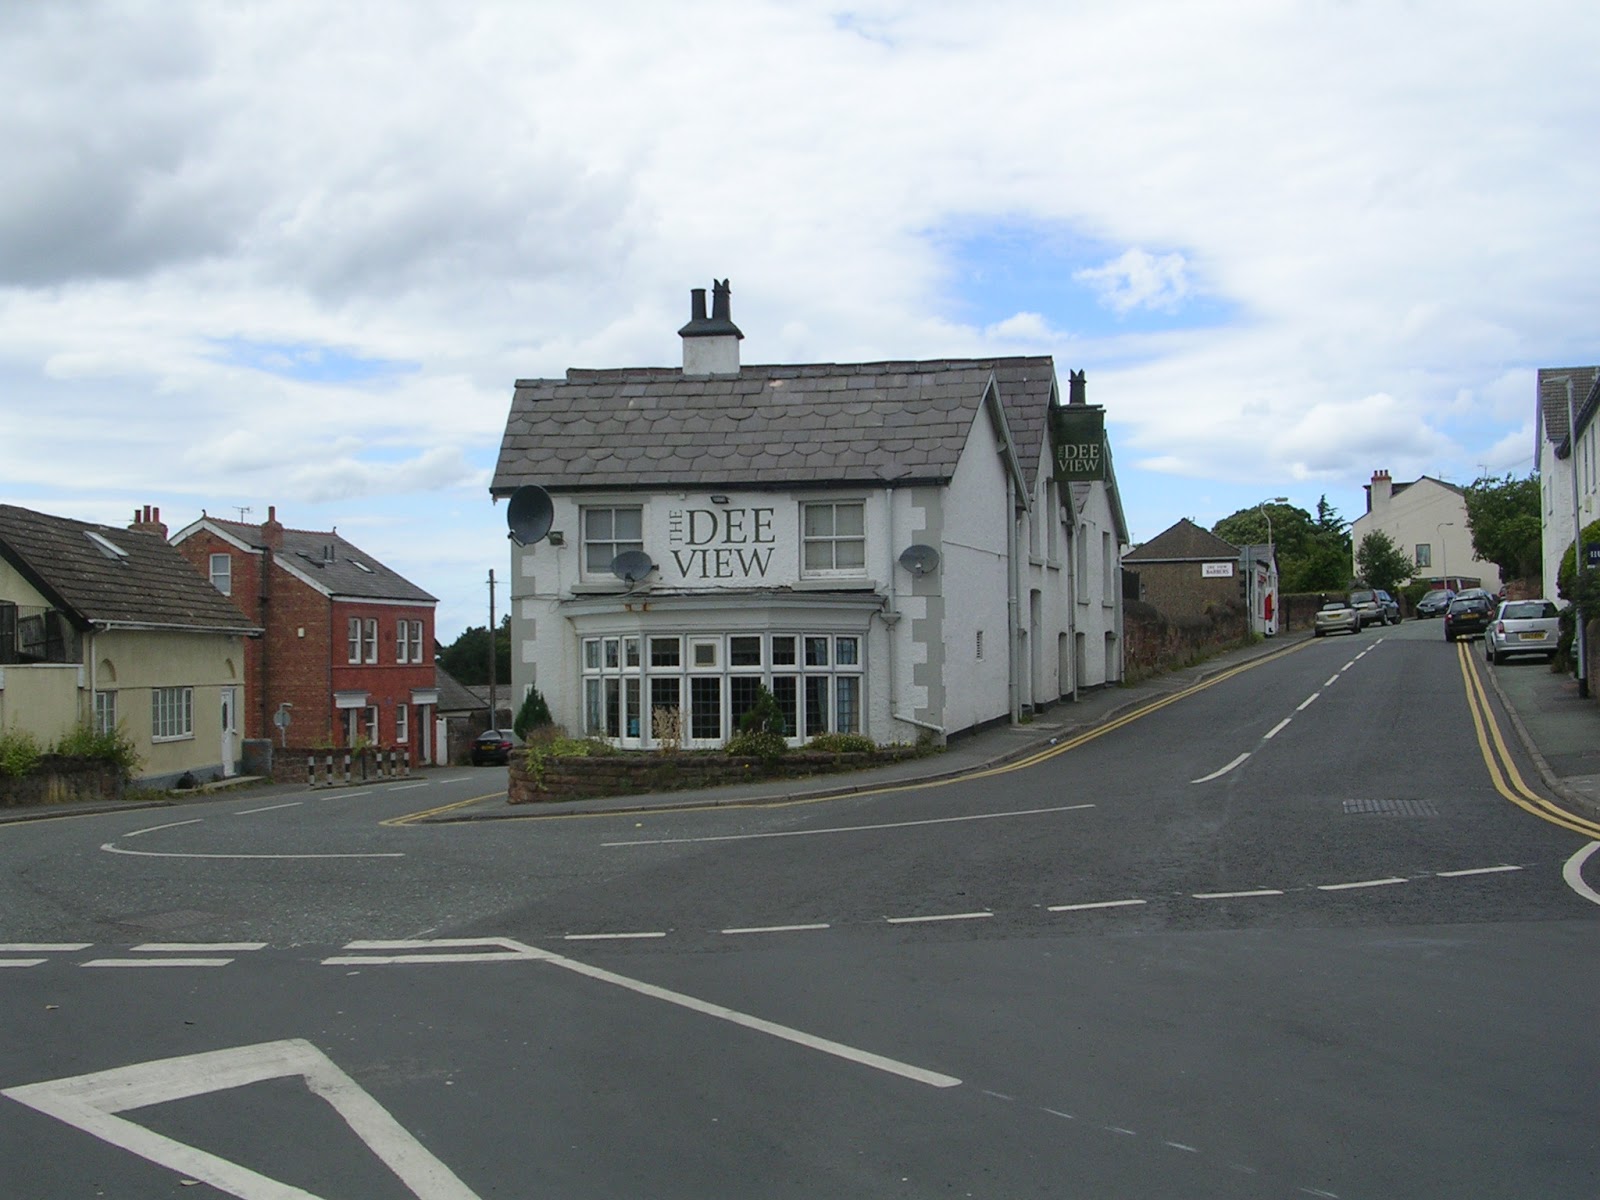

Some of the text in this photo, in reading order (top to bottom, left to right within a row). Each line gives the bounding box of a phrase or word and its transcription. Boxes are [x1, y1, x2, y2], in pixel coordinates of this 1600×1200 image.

[1058, 459, 1099, 472] VIEW
[1064, 444, 1100, 459] DEE
[669, 509, 682, 545] THE
[685, 507, 776, 545] DEE
[670, 547, 776, 579] VIEW
